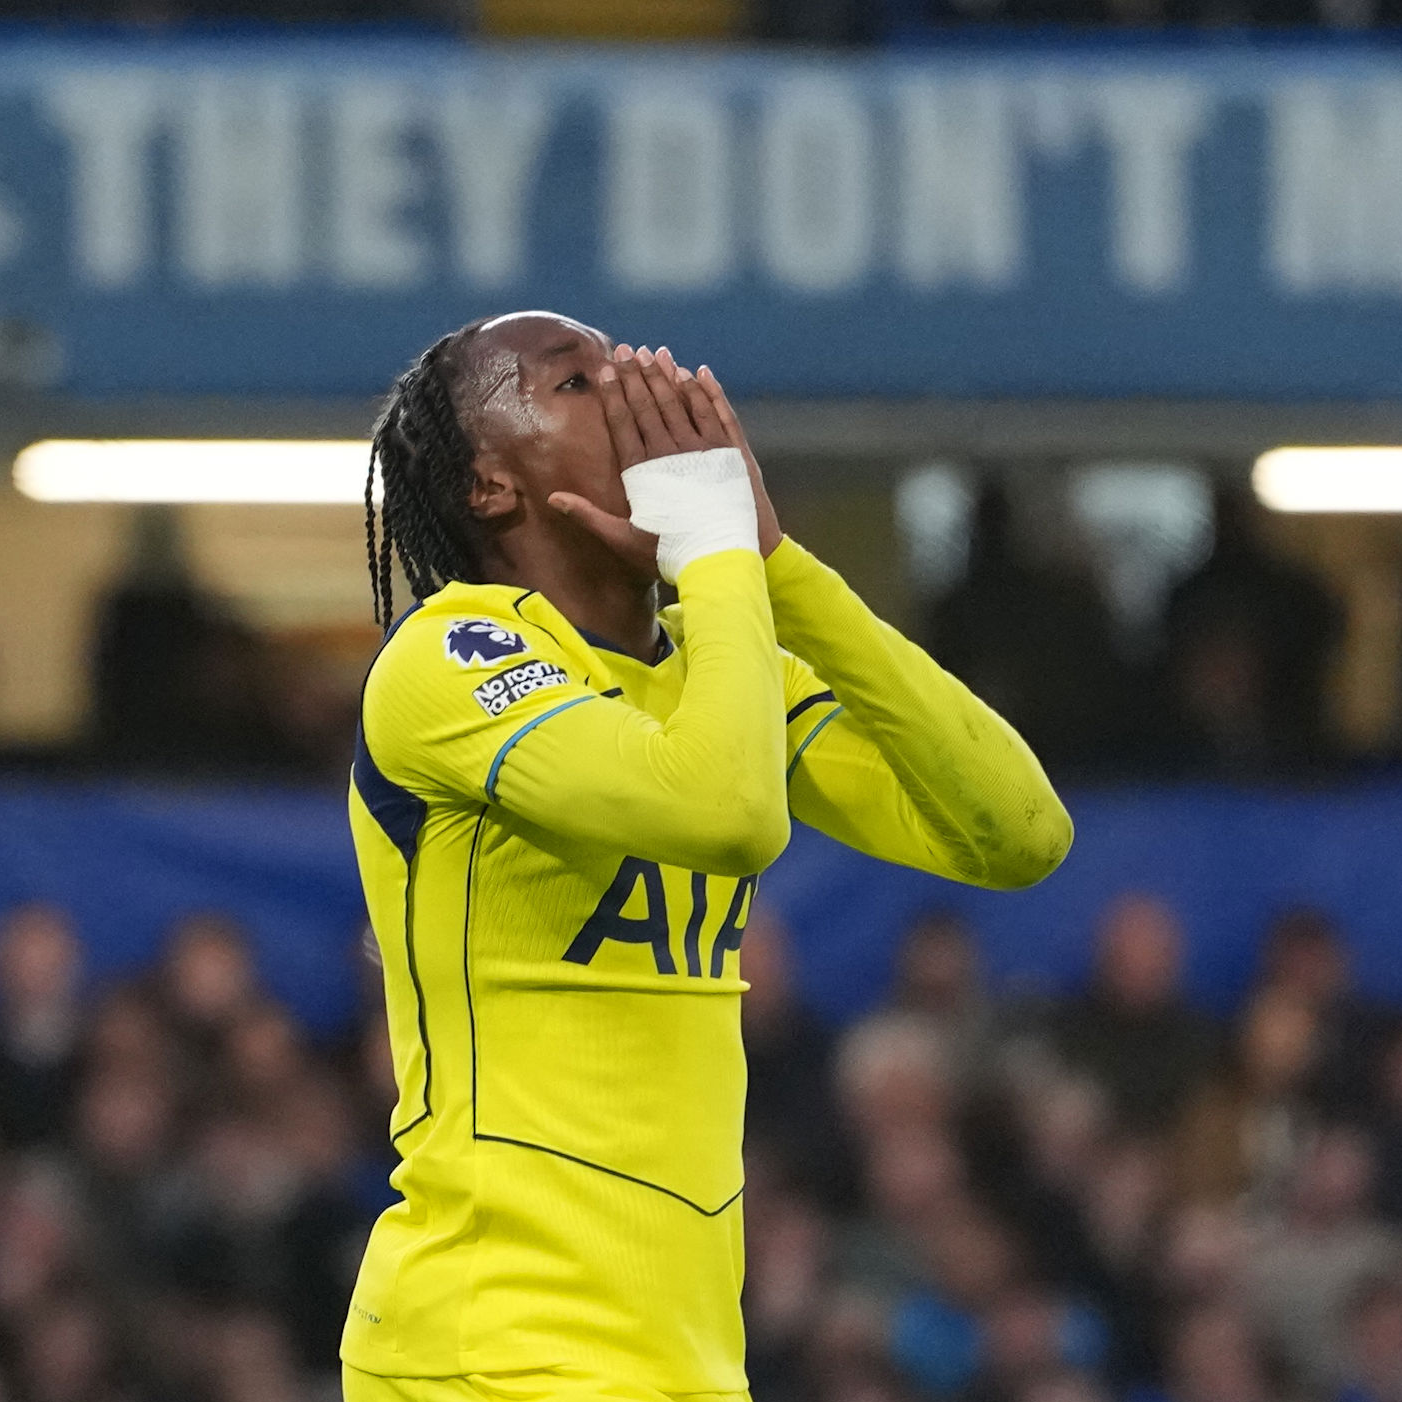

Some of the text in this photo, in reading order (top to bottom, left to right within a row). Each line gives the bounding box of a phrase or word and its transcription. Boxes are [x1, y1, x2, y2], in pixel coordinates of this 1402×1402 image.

[52, 68, 551, 288] THEY
[607, 68, 1202, 292] DON'T
[473, 662, 560, 707] No room
